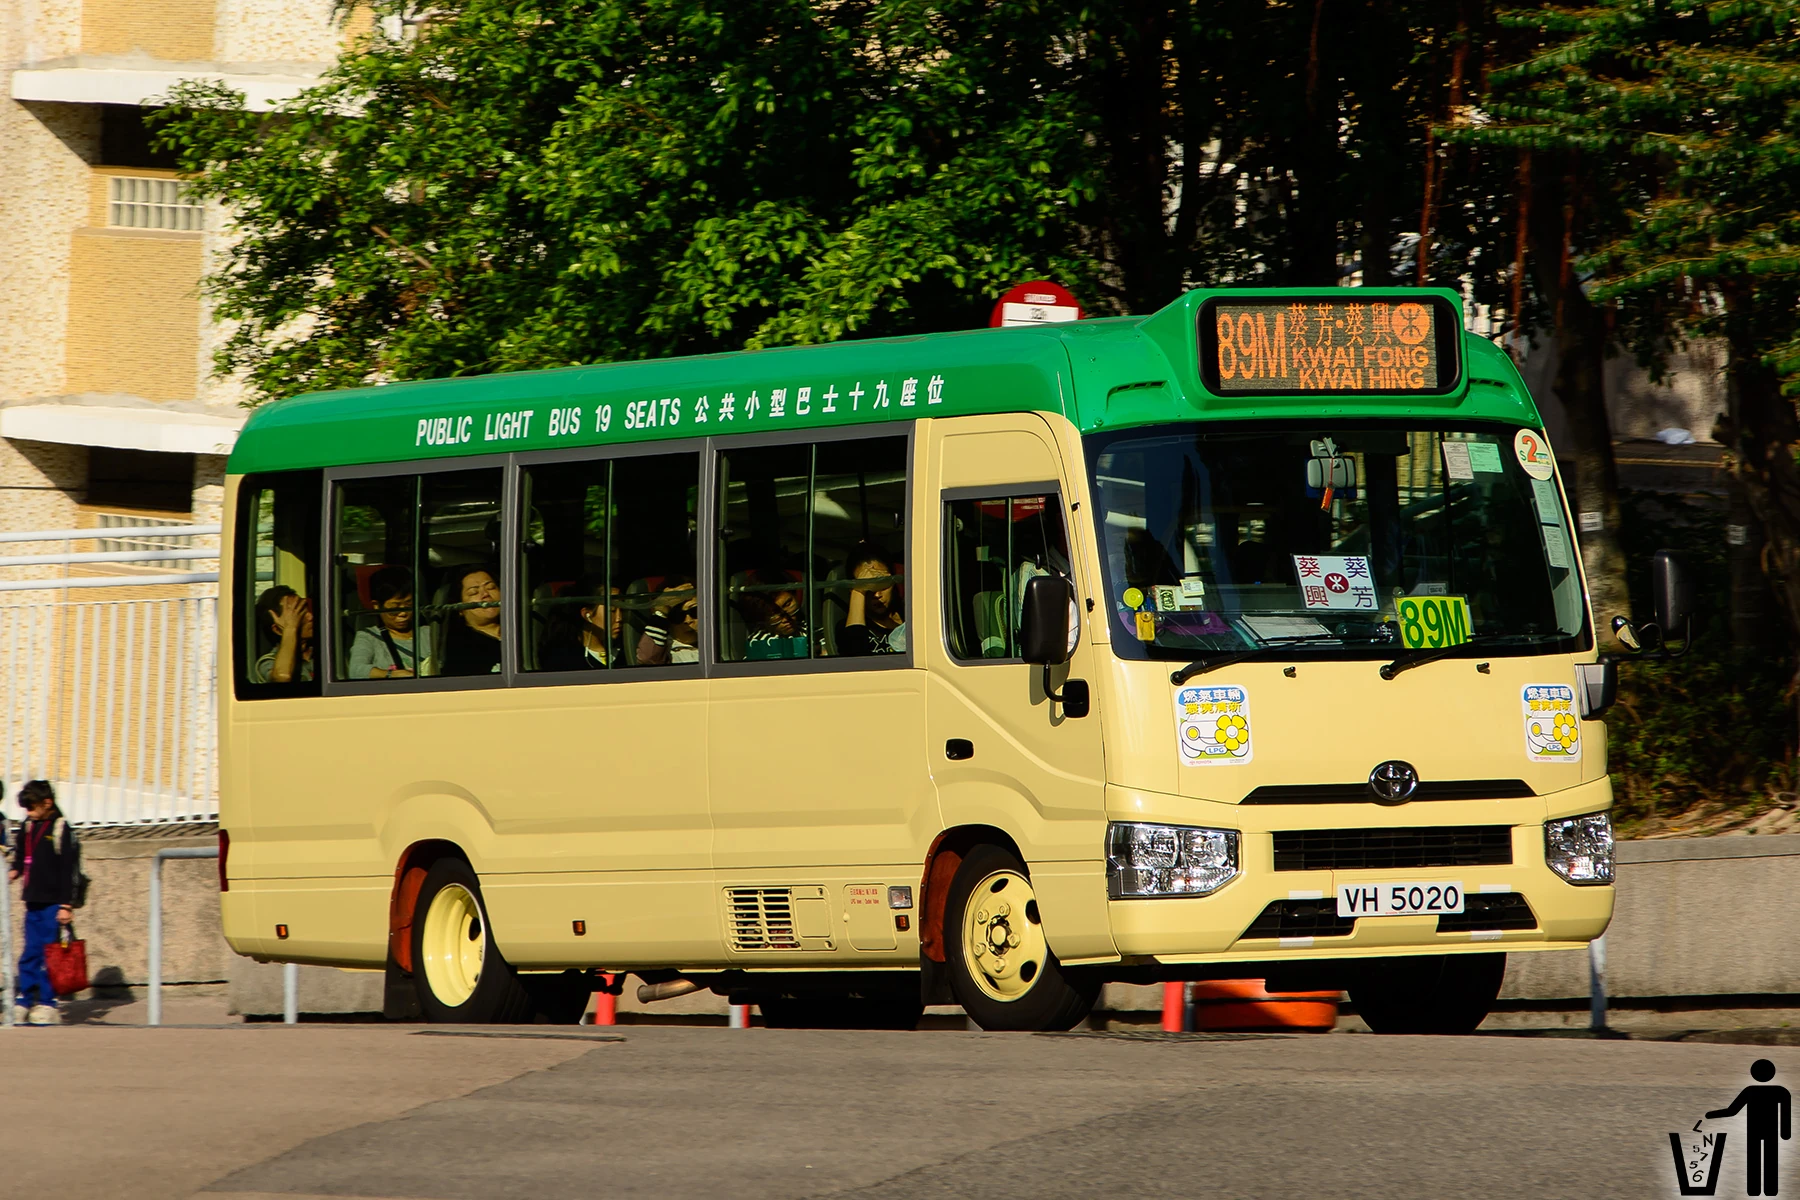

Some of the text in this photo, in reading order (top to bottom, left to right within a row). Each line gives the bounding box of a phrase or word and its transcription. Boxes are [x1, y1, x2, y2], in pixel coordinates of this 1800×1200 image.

[1216, 312, 1288, 380] 89M
[1292, 346, 1430, 368] KWAI FONG
[694, 374, 945, 424] 公共小型巴士十九座位
[1299, 368, 1425, 390] KWAI HING
[415, 397, 681, 446] PUBLIC LIGHT BUS 19 SEATS
[1400, 599, 1468, 649] 89M
[1344, 885, 1459, 912] VH 5020
